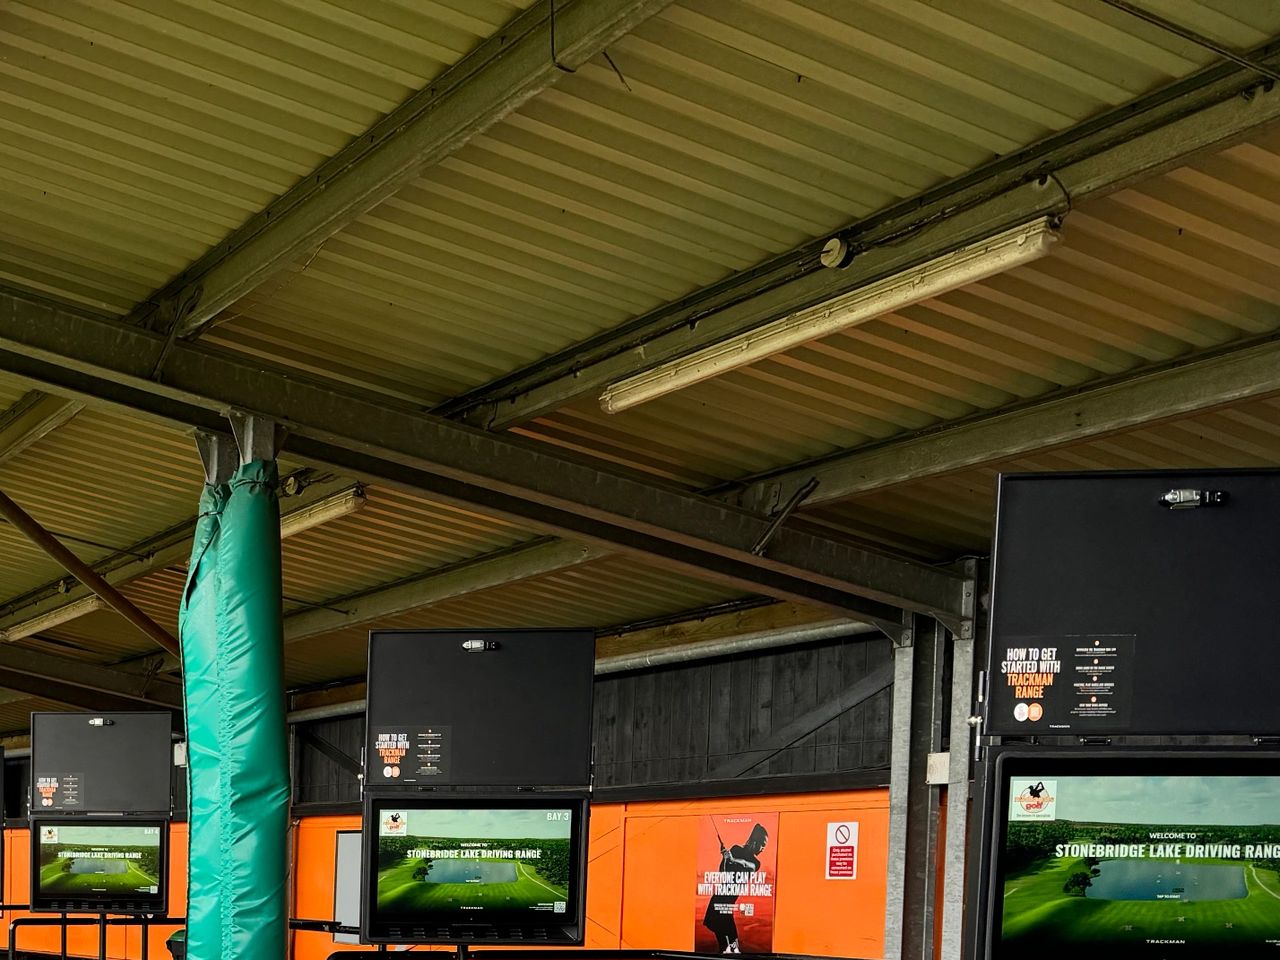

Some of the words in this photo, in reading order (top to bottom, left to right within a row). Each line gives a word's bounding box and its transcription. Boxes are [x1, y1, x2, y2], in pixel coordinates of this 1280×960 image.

[1006, 648, 1027, 661] HOW
[1028, 648, 1040, 661] TO
[1041, 648, 1057, 661] GET
[1001, 661, 1038, 673] STARTED
[1039, 661, 1061, 673] WITH
[1007, 673, 1054, 686] TRACKMAN
[1015, 686, 1044, 699] RANGE
[547, 812, 561, 821] BAY
[563, 812, 569, 821] 3
[406, 849, 459, 858] STONEBRIDGE
[461, 849, 480, 858] LAKE
[481, 850, 513, 858] DRIVING
[515, 850, 541, 859] RANGE
[1055, 844, 1145, 858] STONEBRIDGE
[1149, 844, 1181, 858] LAKE
[1185, 844, 1241, 859] DRIVING
[704, 871, 735, 884] EVERYONE
[736, 871, 749, 884] CAN
[750, 871, 767, 884] PLAY
[697, 883, 713, 896] WITH
[714, 883, 749, 896] TRACKMAN
[750, 883, 772, 896] RANGE
